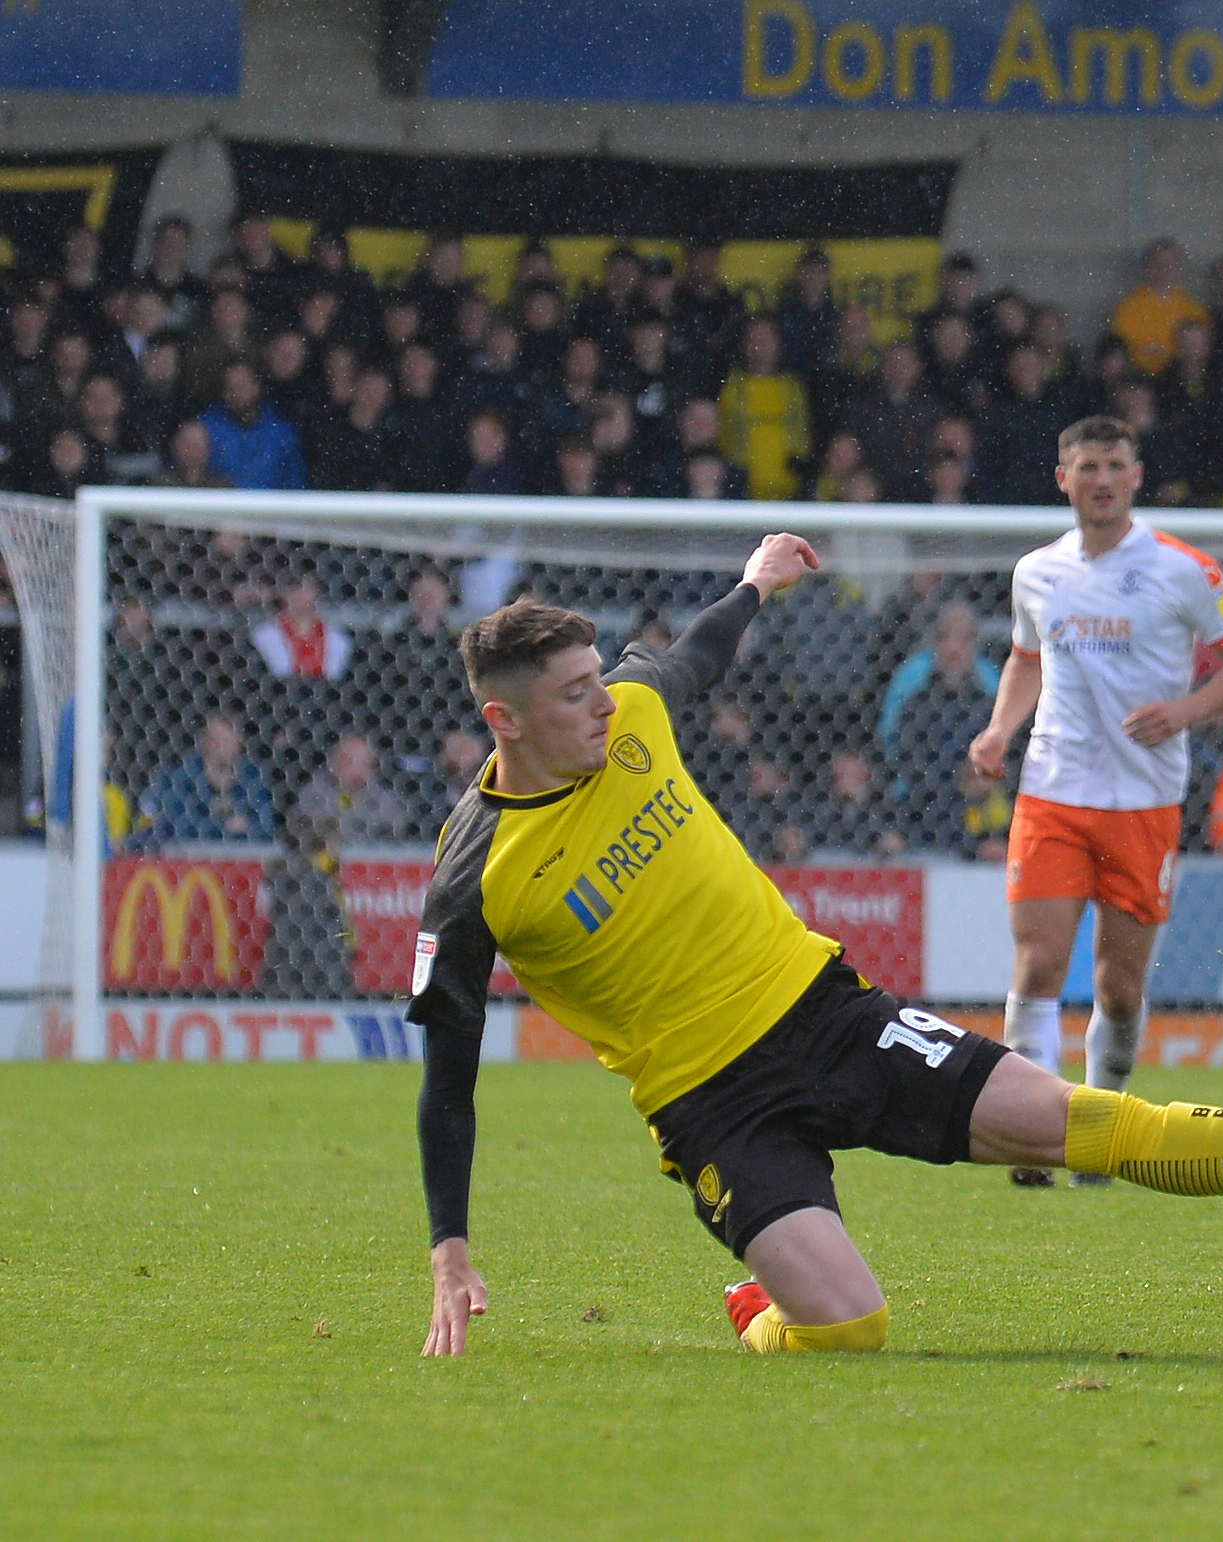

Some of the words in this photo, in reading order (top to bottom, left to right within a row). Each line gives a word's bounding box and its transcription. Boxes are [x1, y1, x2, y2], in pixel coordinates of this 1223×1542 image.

[742, 0, 954, 99] Don
[1076, 616, 1132, 640] STAR
[595, 778, 694, 895] PRESTEC
[876, 1007, 966, 1069] 19
